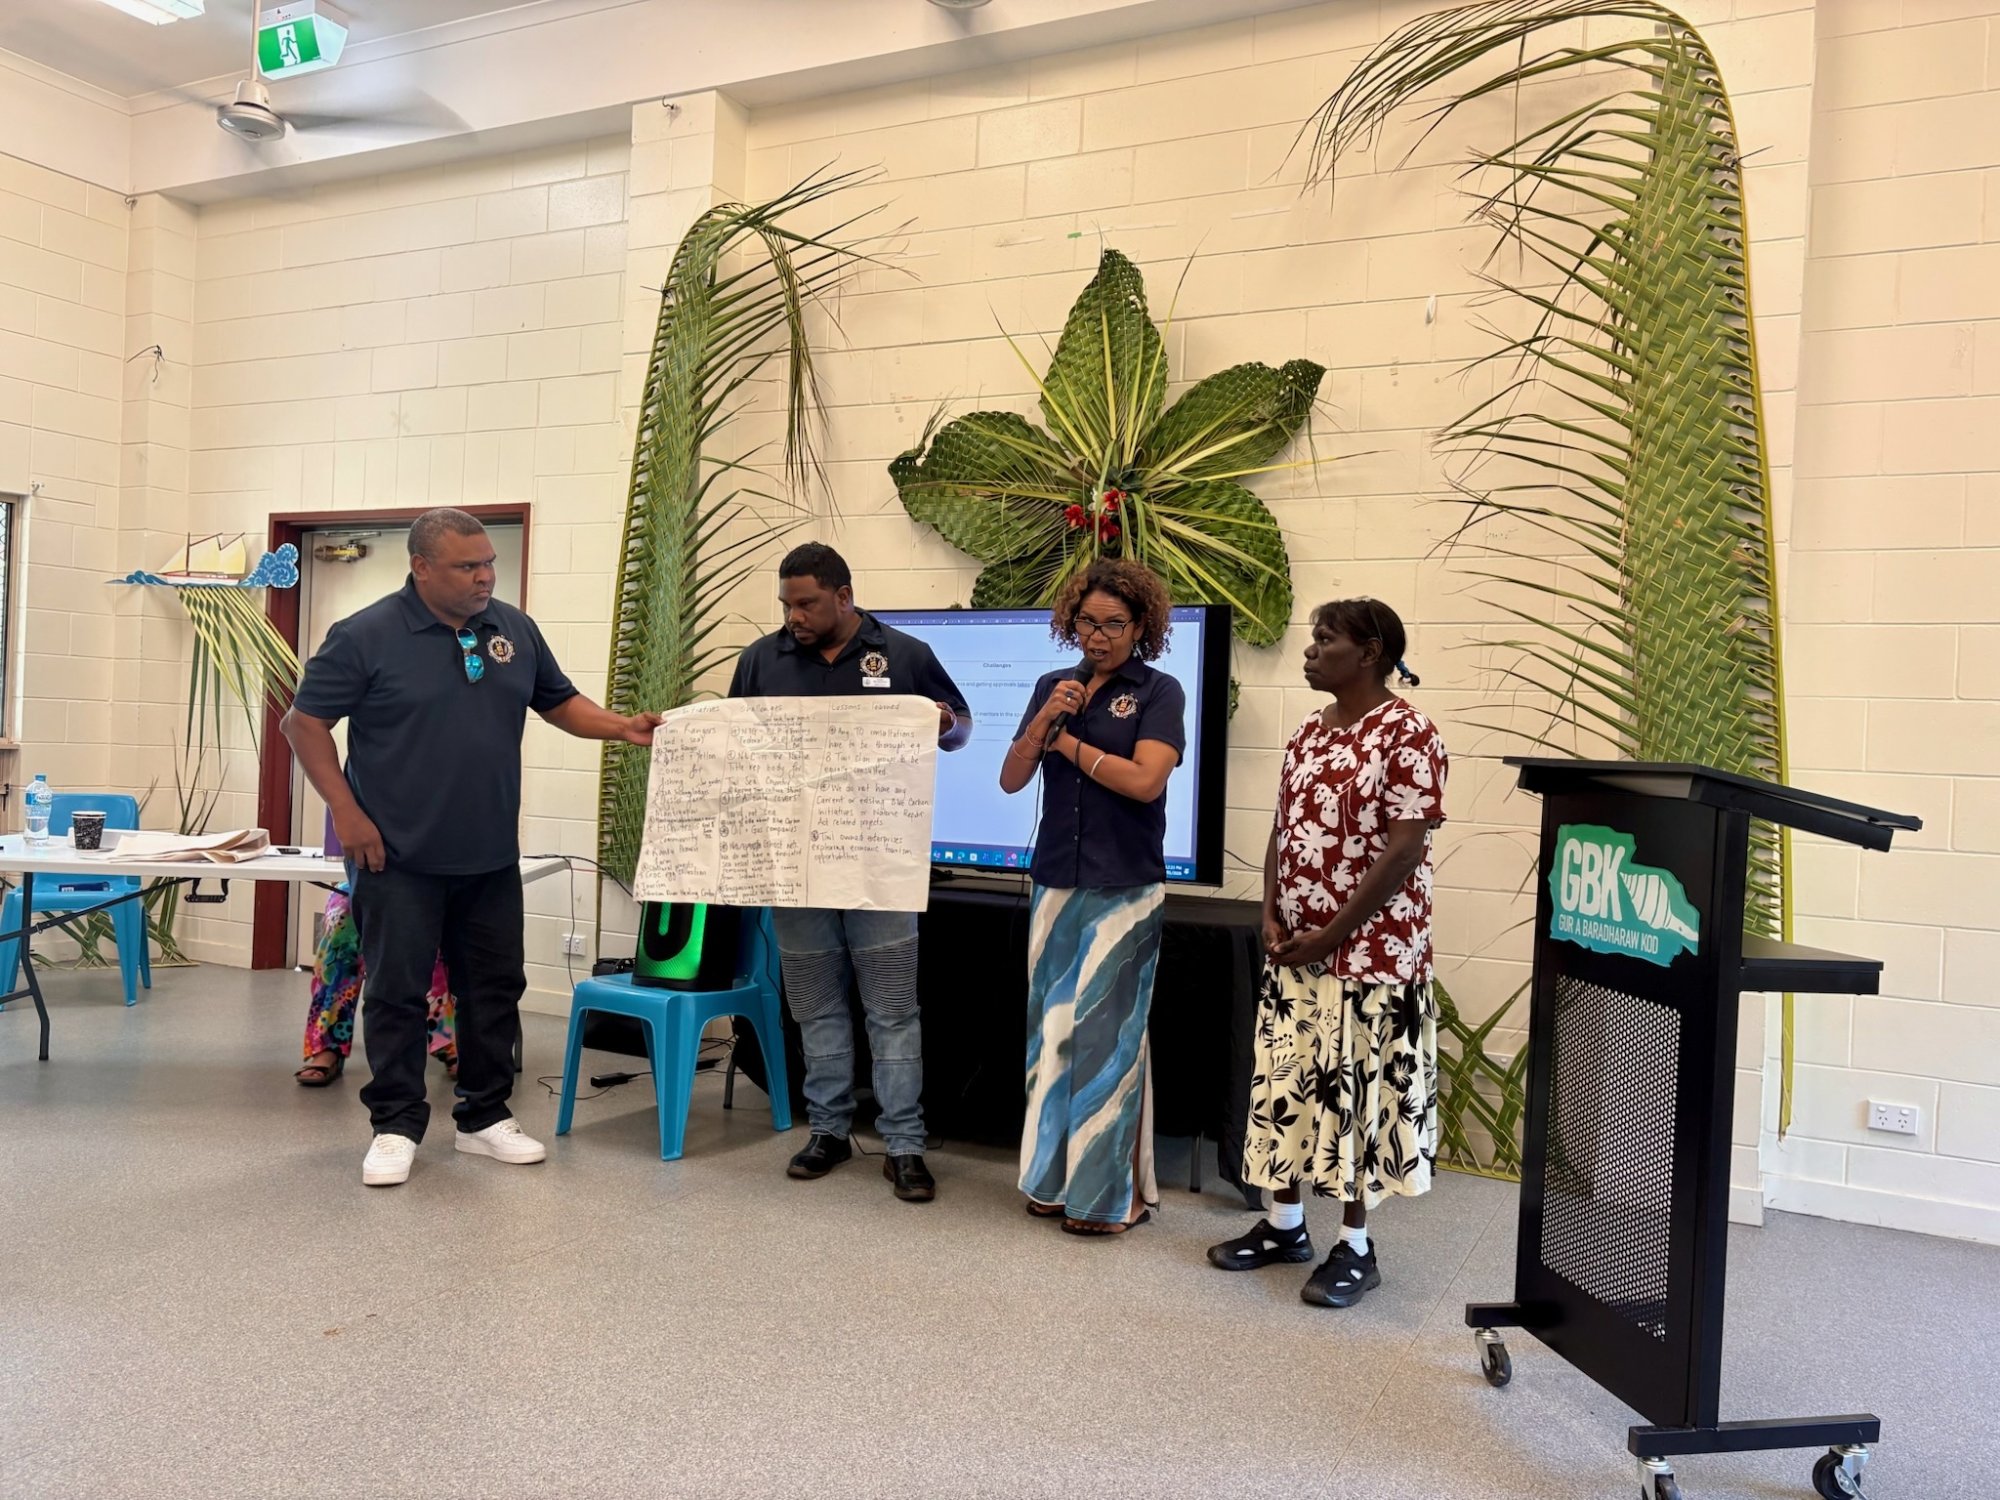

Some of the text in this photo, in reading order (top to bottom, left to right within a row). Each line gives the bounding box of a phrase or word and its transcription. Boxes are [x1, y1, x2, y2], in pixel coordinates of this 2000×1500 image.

[832, 701, 901, 711] Lessons learned
[828, 740, 842, 749] have
[849, 740, 855, 748] to
[861, 741, 868, 749] be
[910, 755, 919, 765] be
[831, 783, 842, 792] We
[857, 783, 869, 792] not
[875, 783, 890, 793] have
[833, 818, 856, 826] related
[1560, 838, 1625, 922] GBK
[1558, 914, 1659, 954] GUR A BARADHARAW KOD
